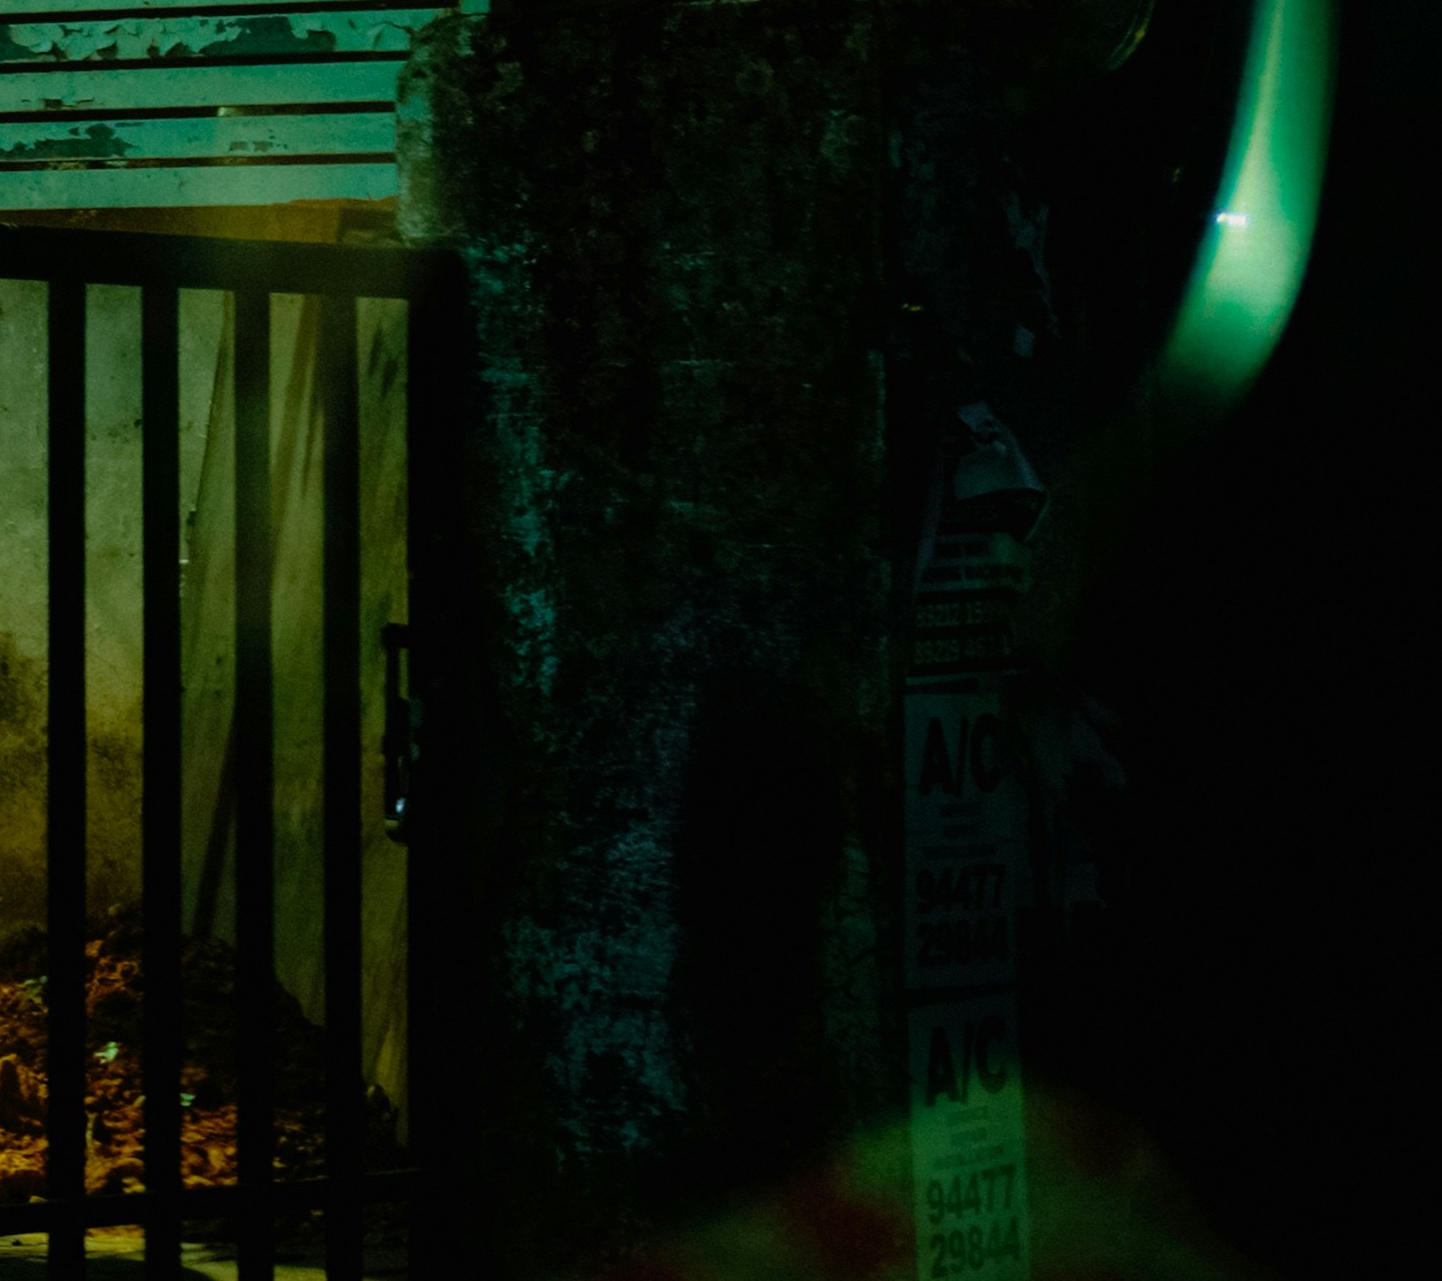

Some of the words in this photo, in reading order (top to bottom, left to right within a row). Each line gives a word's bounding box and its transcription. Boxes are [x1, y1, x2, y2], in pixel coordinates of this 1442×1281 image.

[918, 712, 1003, 799] A/C
[924, 1013, 1009, 1107] A/C
[926, 1164, 1017, 1225] 94477
[929, 1215, 1021, 1279] 29844
